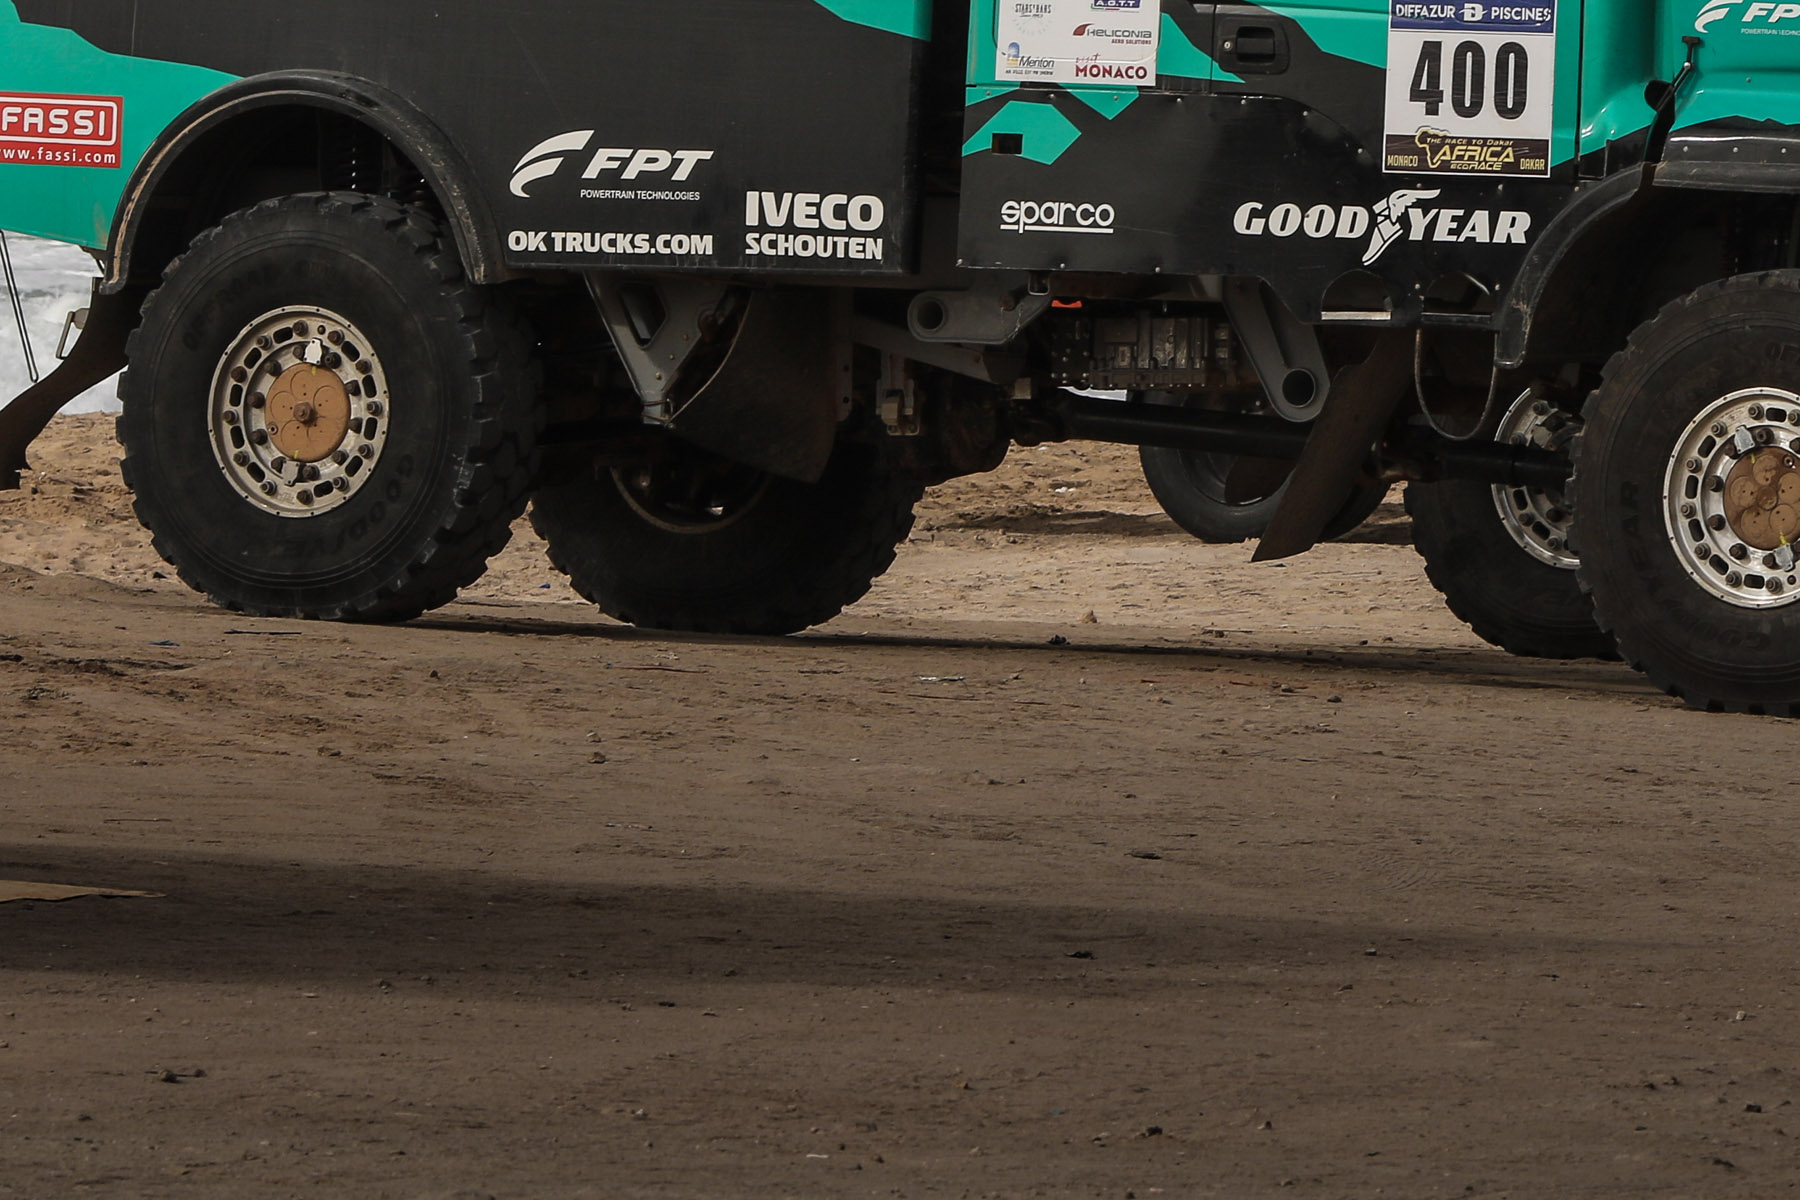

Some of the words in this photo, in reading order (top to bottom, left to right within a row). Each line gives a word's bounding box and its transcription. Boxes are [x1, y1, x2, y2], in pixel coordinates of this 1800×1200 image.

[1396, 4, 1455, 18] DIFFAZUR
[1491, 7, 1551, 22] PISCINES
[1075, 64, 1148, 80] MONACO
[1409, 40, 1528, 120] 400
[1, 107, 107, 136] FASSI
[0, 146, 116, 164] ww.fassi.com
[581, 147, 715, 181] FPT
[1387, 154, 1419, 167] MONACO
[1433, 145, 1514, 163] AFRICA
[1520, 157, 1545, 170] DAKAR
[580, 189, 635, 201] POWERTRAIN
[636, 190, 700, 201] TECHNOLOGIES
[745, 191, 885, 231] IVECO
[1001, 201, 1114, 233] sparco
[507, 230, 548, 253] OK
[552, 232, 713, 255] TRUCKS.COM
[745, 233, 884, 261] SCHOUTEN
